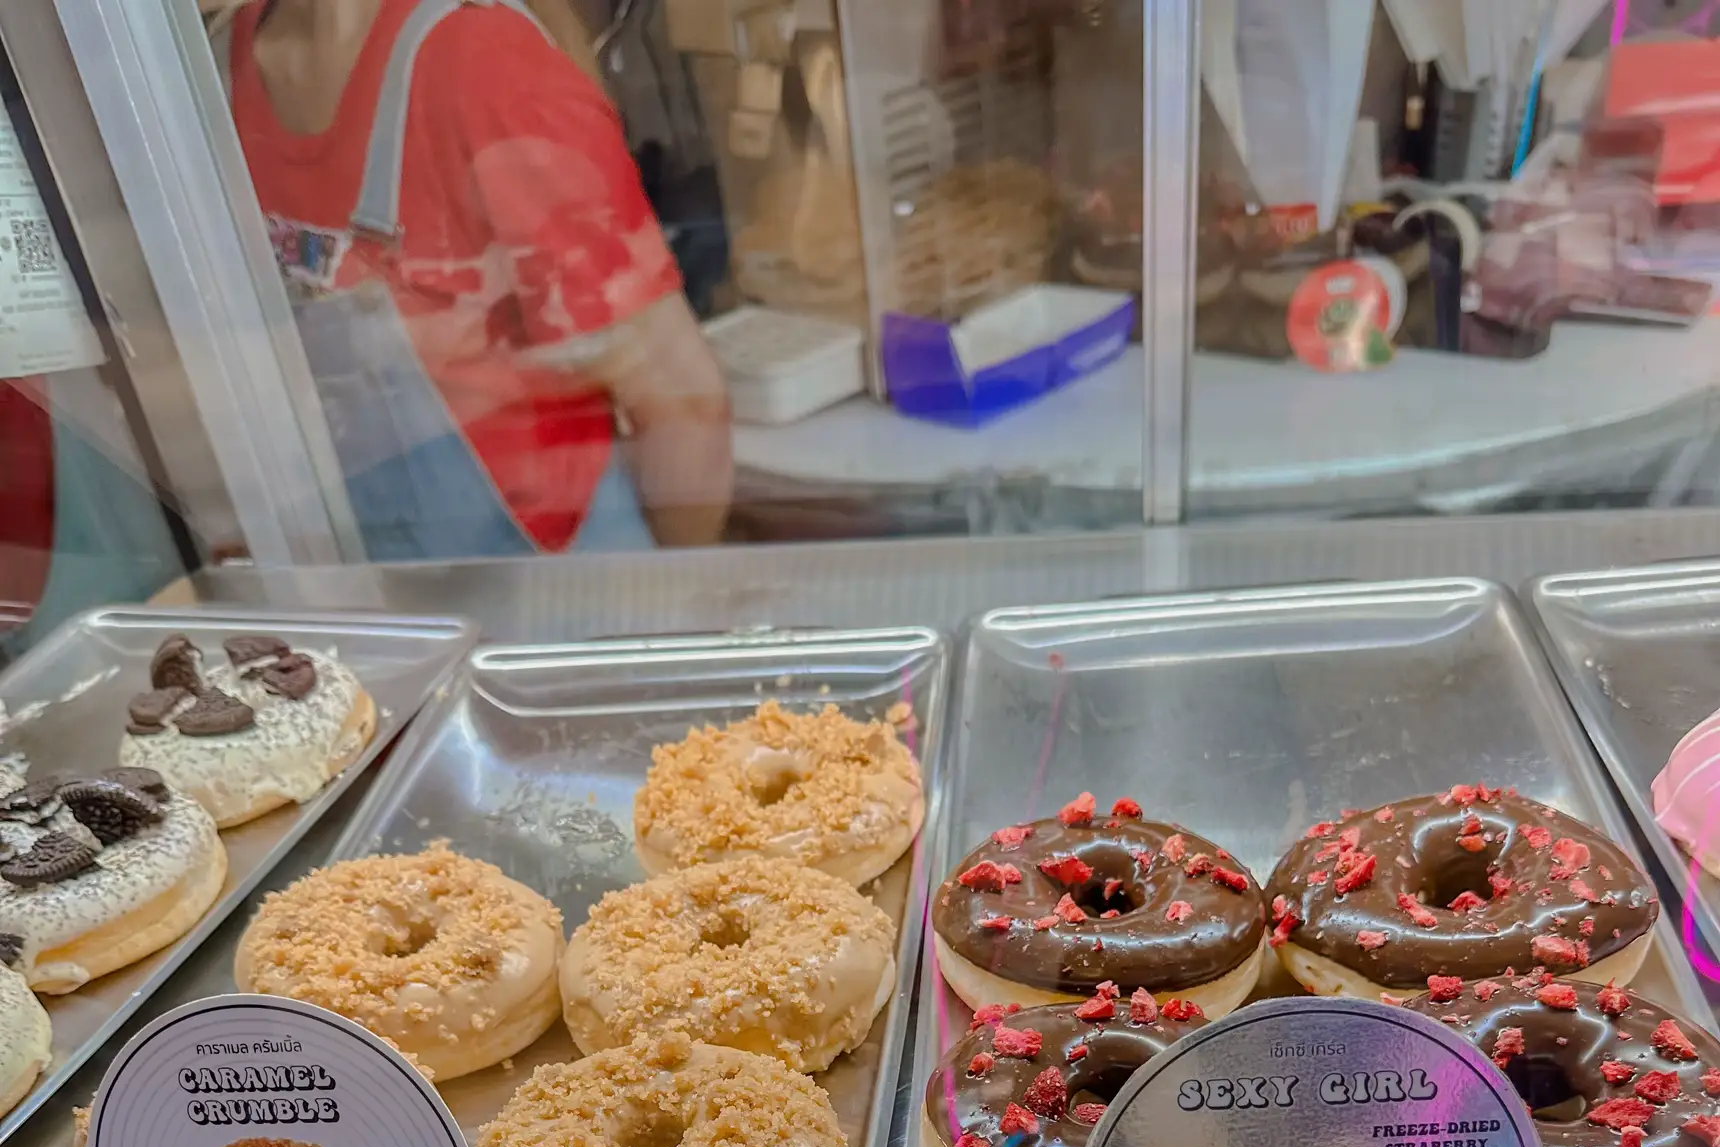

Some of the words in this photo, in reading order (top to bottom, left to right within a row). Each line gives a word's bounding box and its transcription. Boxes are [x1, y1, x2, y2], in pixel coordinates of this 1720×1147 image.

[196, 1042, 249, 1055] คาราเมล
[253, 1034, 303, 1054] ครัมเบิ้ล
[178, 1064, 336, 1094] CARAMEL
[1177, 1075, 1299, 1111] SEXY
[1318, 1068, 1438, 1105] GIRL
[187, 1097, 340, 1126] CRUMBLE
[1372, 1119, 1501, 1139] FREEZE-DRIED
